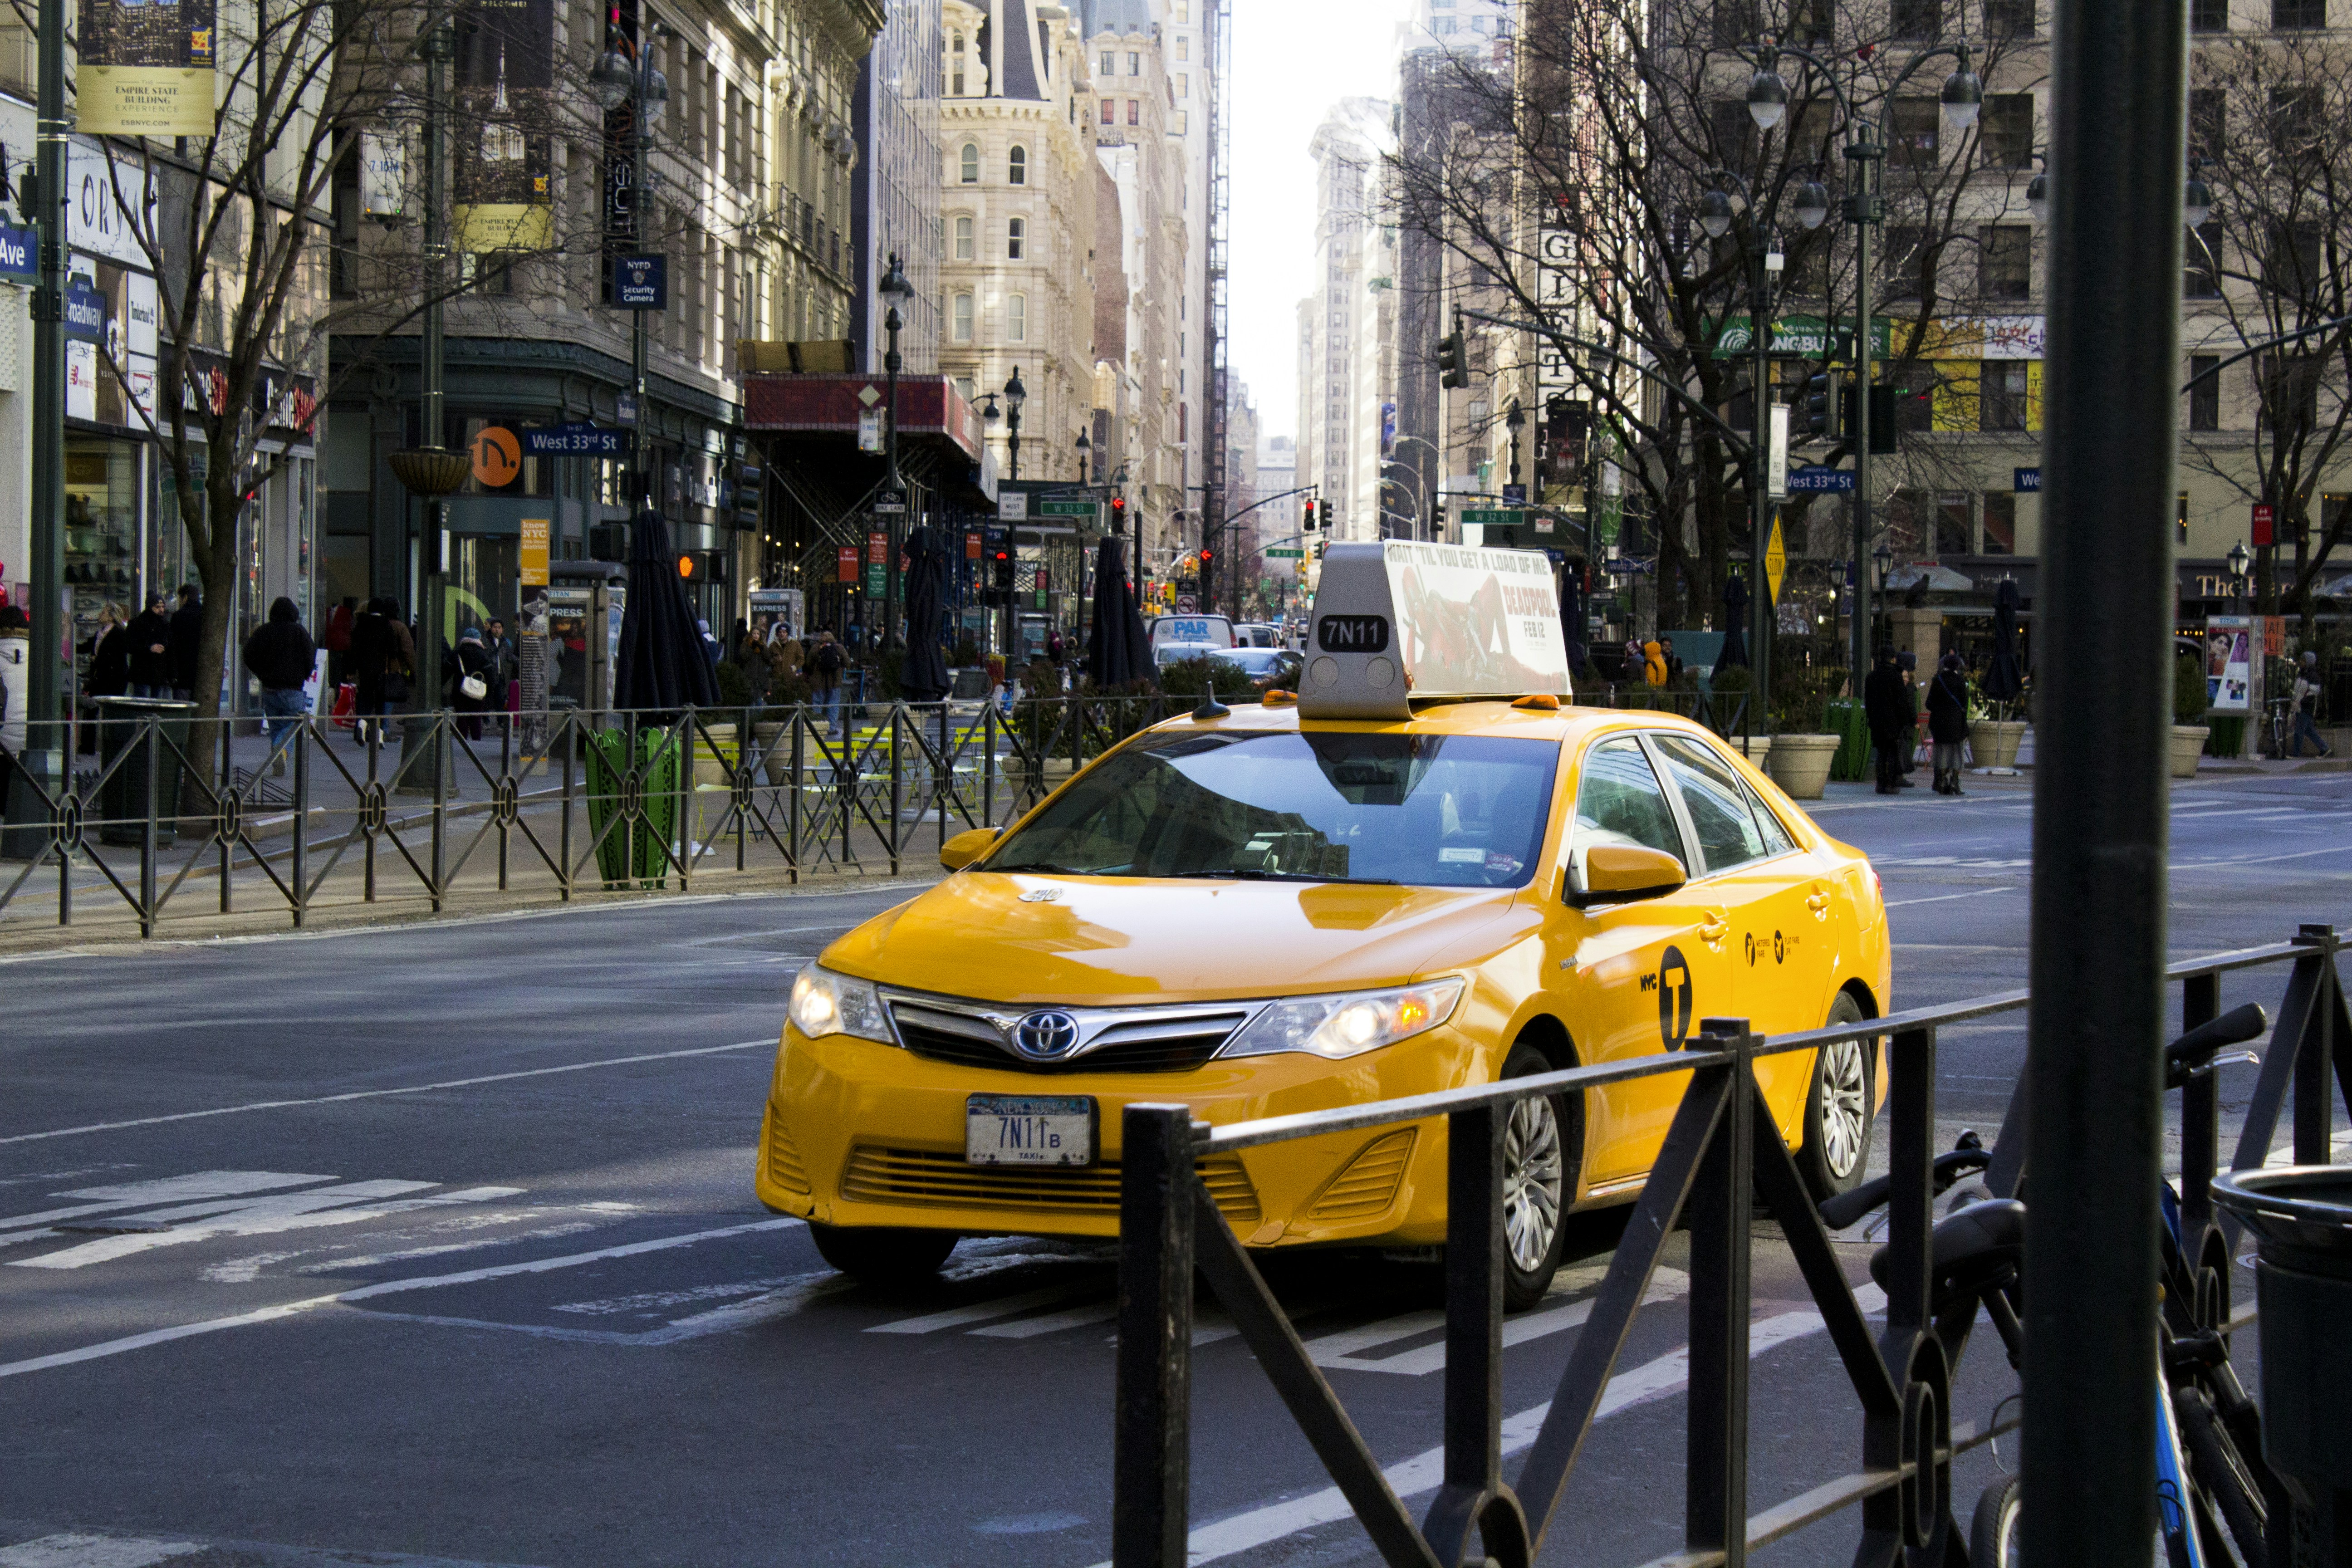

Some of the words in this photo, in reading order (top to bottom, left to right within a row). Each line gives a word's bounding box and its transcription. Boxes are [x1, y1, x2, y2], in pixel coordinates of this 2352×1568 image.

[115, 86, 150, 94] EMPIRE
[125, 95, 171, 104] BUILDING
[115, 104, 178, 113] EXPERIENCE
[0, 237, 25, 266] Ave
[623, 286, 655, 295] Security
[68, 297, 102, 334] roadway
[532, 435, 568, 449] West
[572, 434, 598, 449] 33rd
[602, 435, 617, 450] St
[1814, 475, 1836, 488] 33rd
[1839, 475, 1851, 488] St
[2021, 473, 2041, 486] We
[1077, 505, 1084, 513] St
[1475, 512, 1483, 521] W
[1487, 512, 1497, 521] 32
[1500, 512, 1509, 521] St
[523, 529, 547, 538] NYC
[1387, 544, 1414, 564] WAIT
[1416, 545, 1437, 566] 'TIL
[1436, 548, 1459, 568] YOU
[1459, 550, 1480, 569] GET
[1481, 552, 1490, 570] A
[1490, 553, 1518, 573] LOAD
[1517, 556, 1530, 574] OF
[1532, 557, 1548, 576] ME
[1769, 558, 1782, 576] SLOW
[1502, 585, 1557, 618] DEADPOOL
[550, 608, 583, 617] PRESS
[1174, 621, 1209, 635] PAR
[1326, 621, 1378, 644] 7N11
[1524, 621, 1538, 637] FEB
[1537, 622, 1546, 638] 12
[1756, 938, 1770, 947] METERED
[1792, 936, 1800, 944] FARE
[1757, 950, 1765, 958] FARE
[1640, 972, 1657, 993] NYC
[1665, 966, 1685, 1039] T
